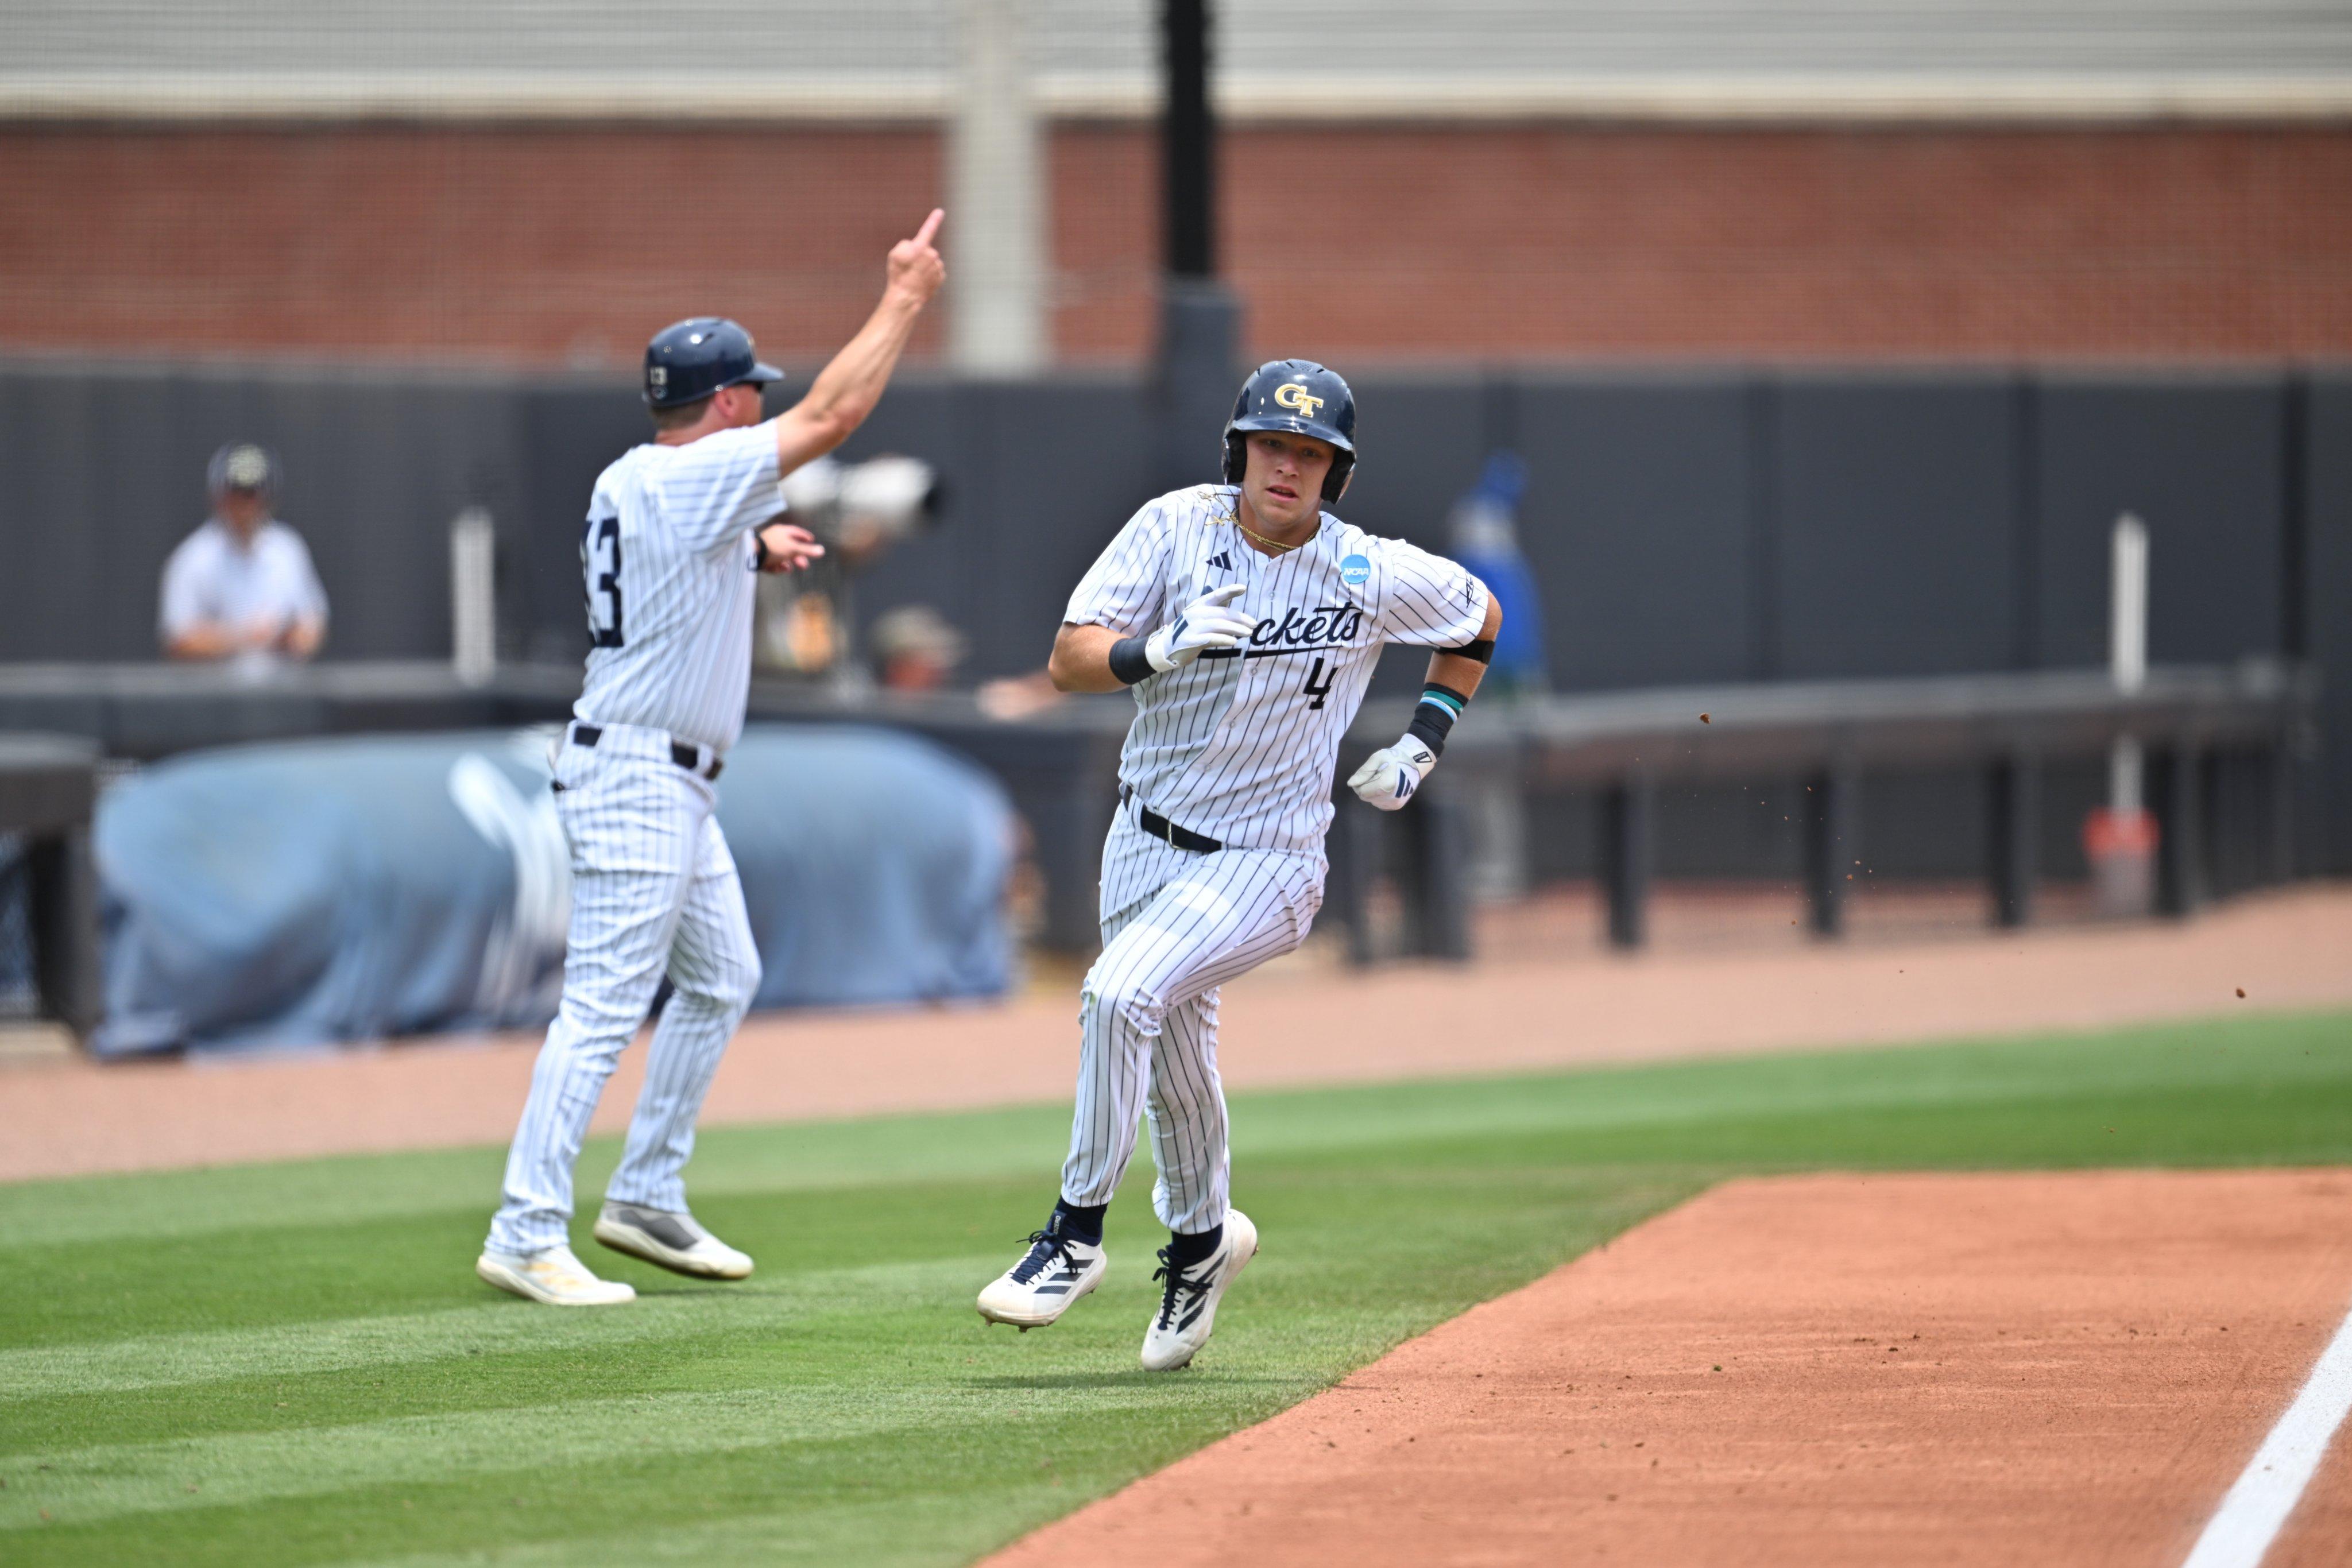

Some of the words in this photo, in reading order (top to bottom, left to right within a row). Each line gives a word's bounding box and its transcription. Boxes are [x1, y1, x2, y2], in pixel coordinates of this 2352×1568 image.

[1274, 383, 1324, 418] GT
[1343, 567, 1369, 576] NCAA
[1303, 657, 1339, 710] 4
